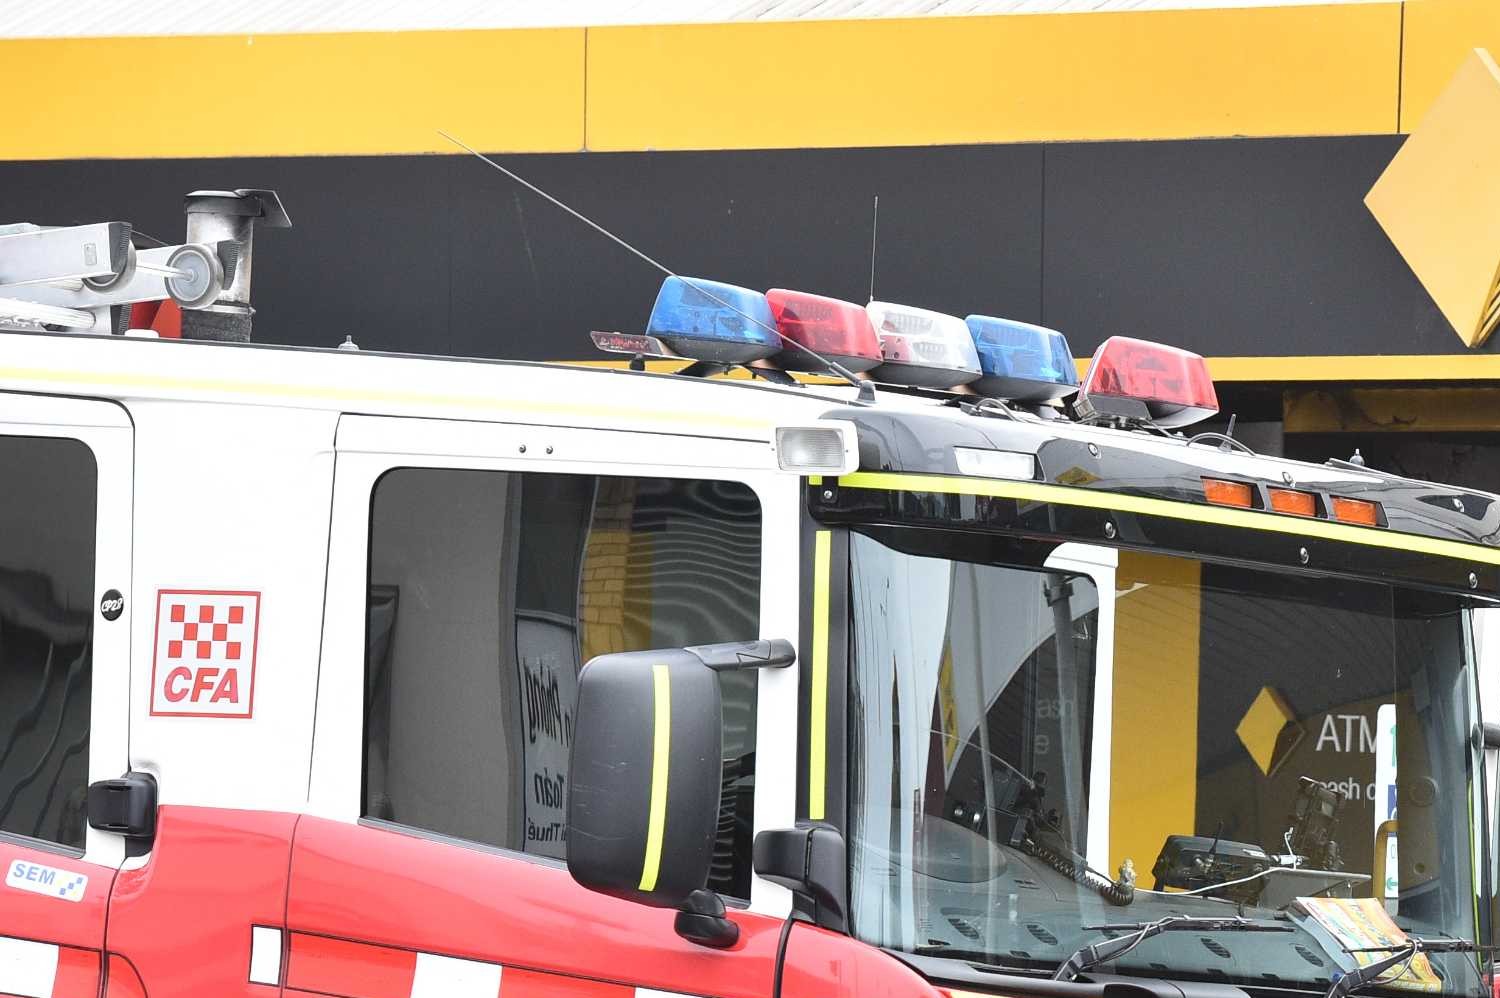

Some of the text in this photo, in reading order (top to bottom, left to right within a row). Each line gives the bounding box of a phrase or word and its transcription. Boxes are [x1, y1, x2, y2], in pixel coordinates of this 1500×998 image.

[164, 666, 239, 703] CFA
[1315, 714, 1377, 754] ATM
[13, 863, 56, 885] SEM
